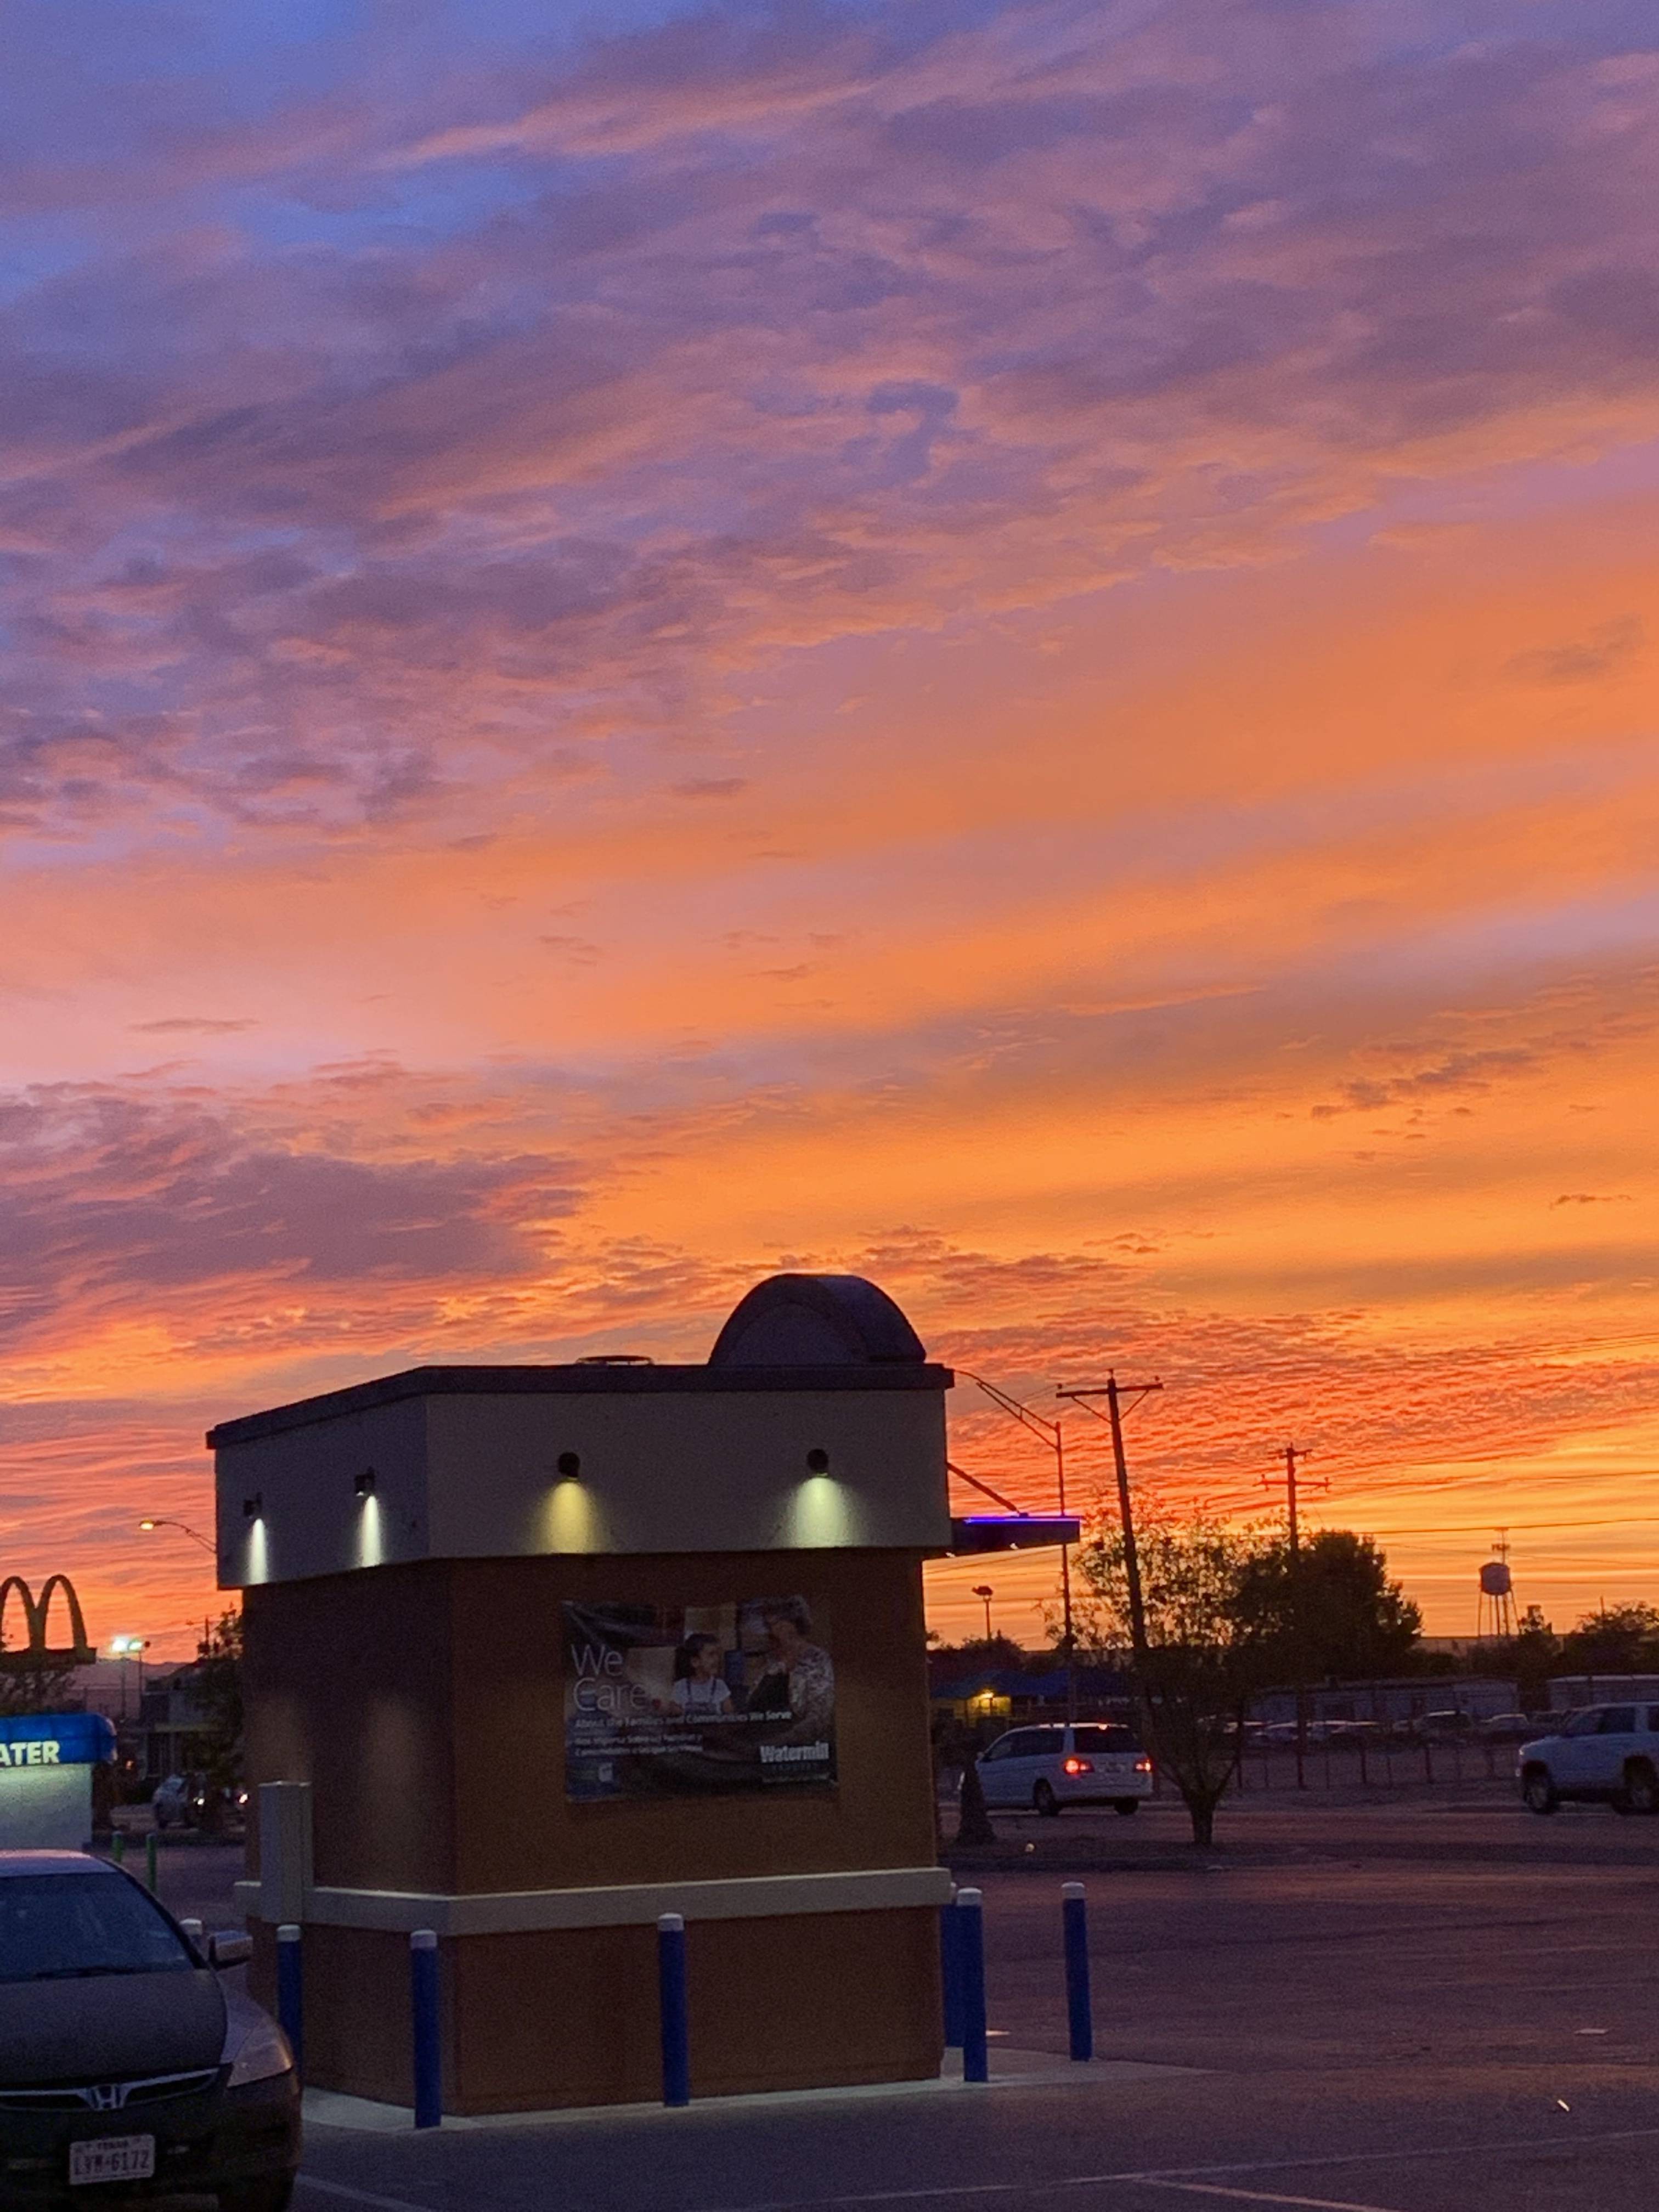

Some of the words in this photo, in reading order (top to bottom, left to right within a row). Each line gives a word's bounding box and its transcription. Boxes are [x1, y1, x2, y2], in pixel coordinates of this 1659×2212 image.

[571, 1643, 623, 1677] We
[573, 1677, 646, 1712] Care
[766, 1710, 792, 1720] Serve
